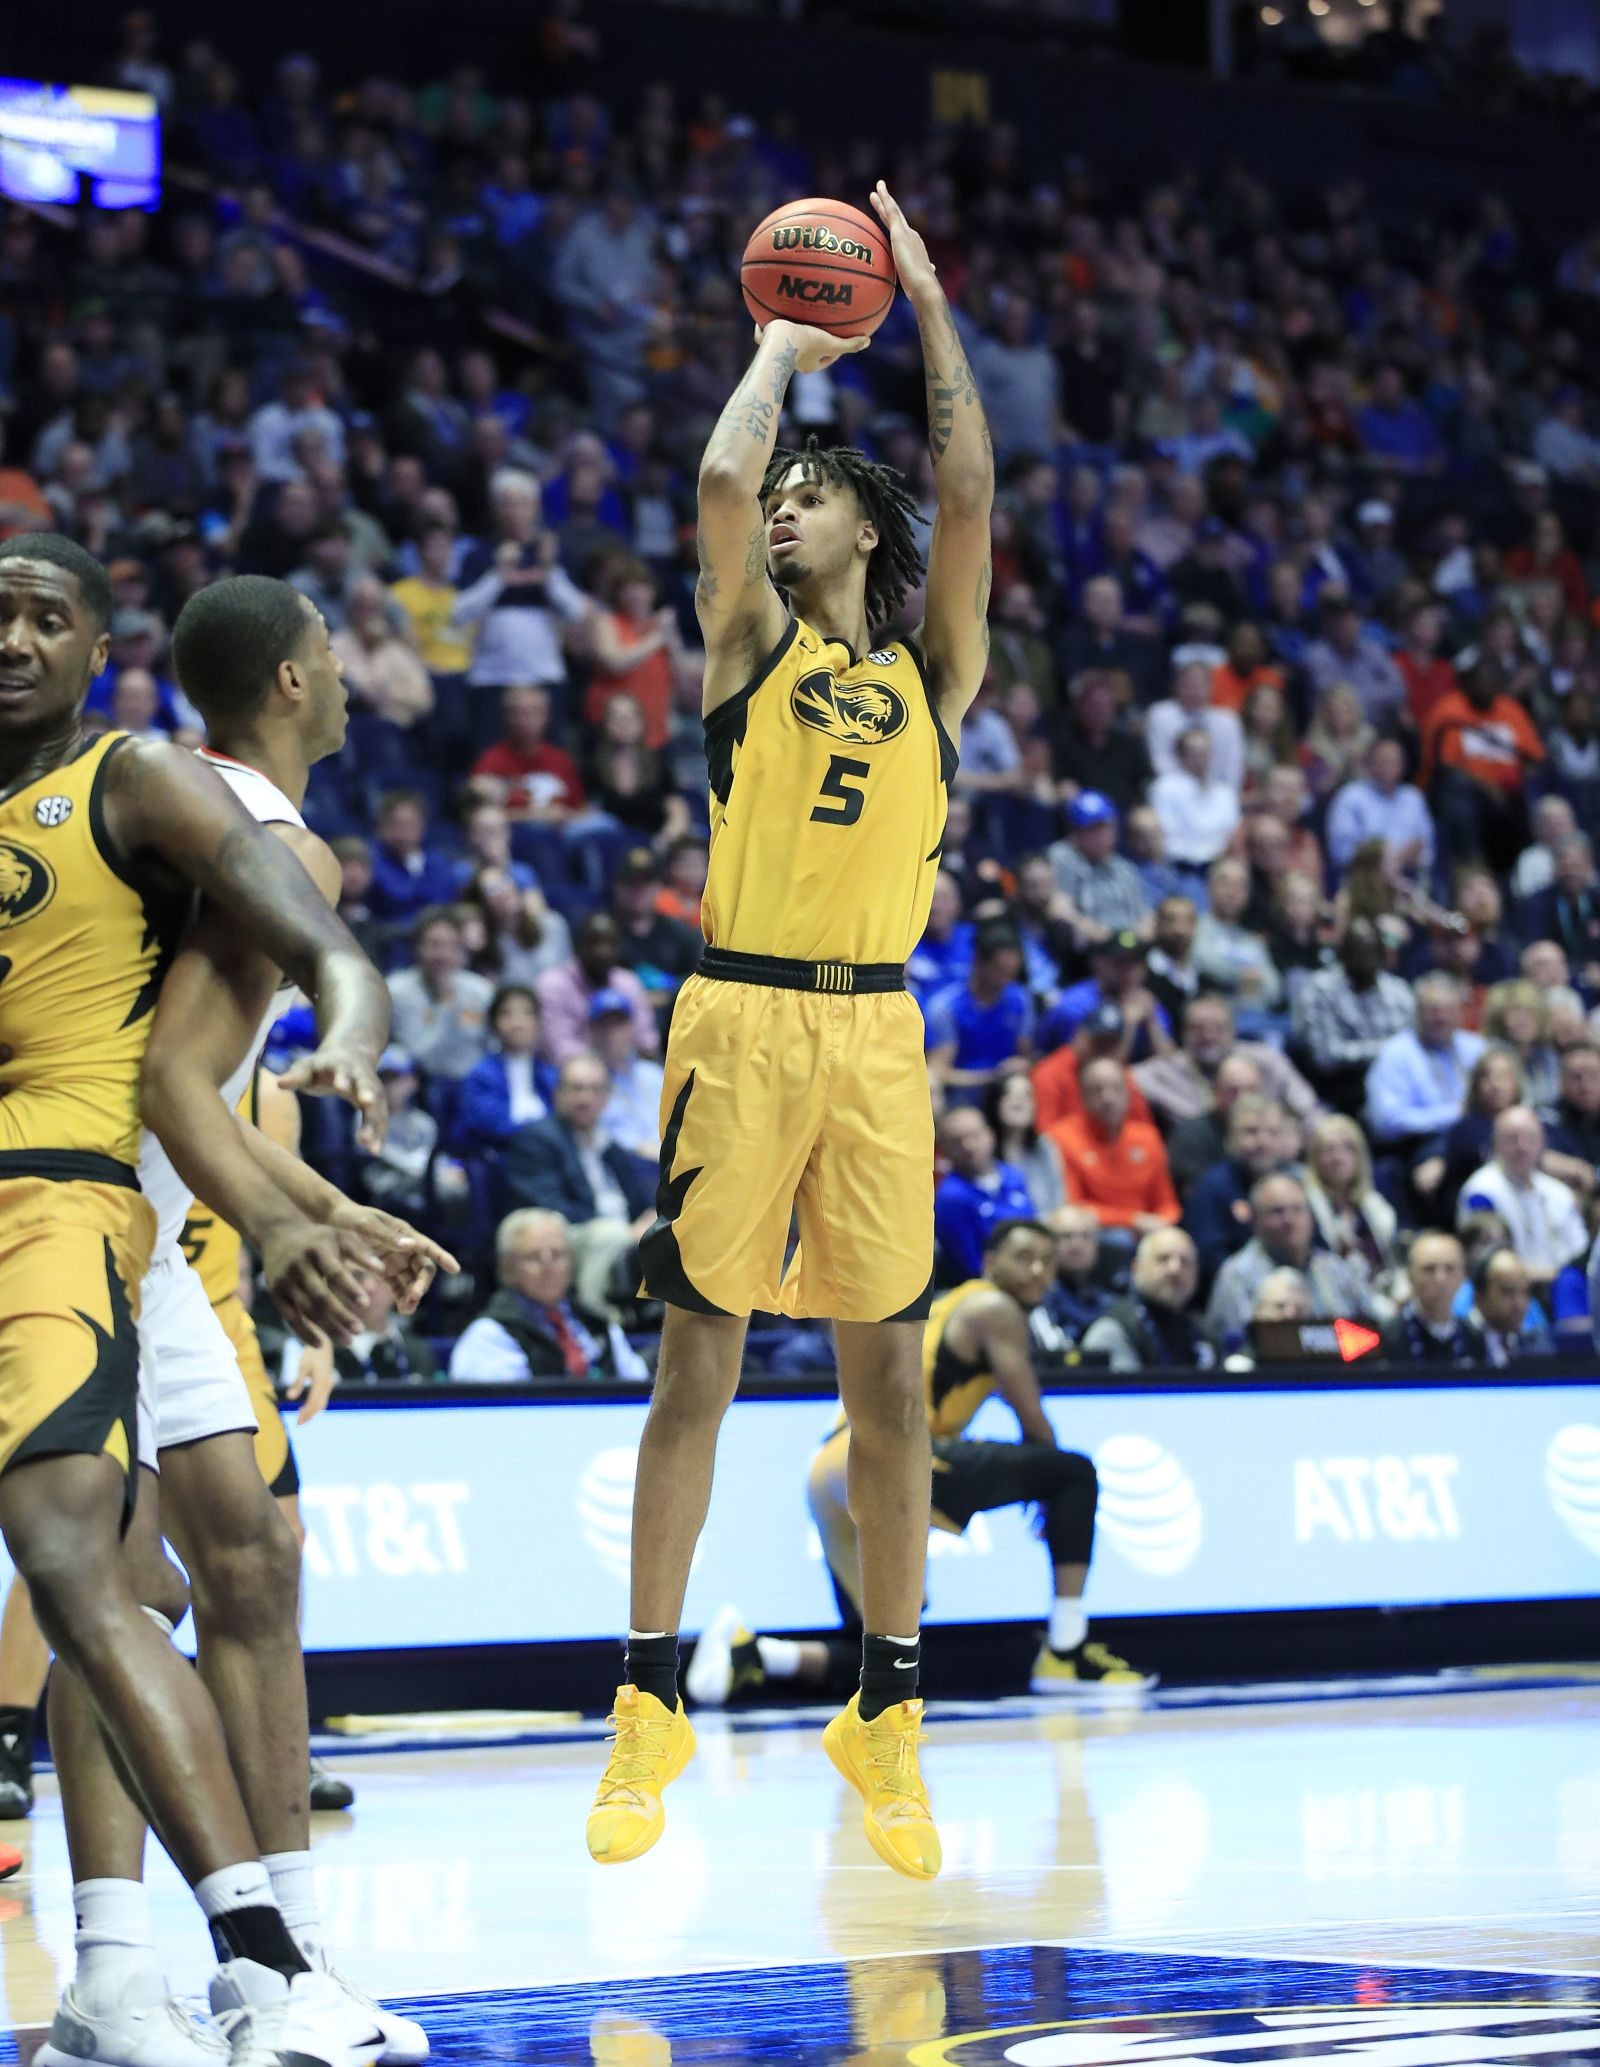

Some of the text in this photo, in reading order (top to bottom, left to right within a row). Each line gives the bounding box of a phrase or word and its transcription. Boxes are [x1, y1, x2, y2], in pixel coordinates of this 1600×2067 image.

[773, 226, 872, 266] Wilson
[776, 274, 853, 305] NCAA
[867, 651, 897, 666] SEC
[810, 754, 870, 826] 5
[36, 796, 72, 827] SEC
[1294, 1454, 1463, 1544] AT&T
